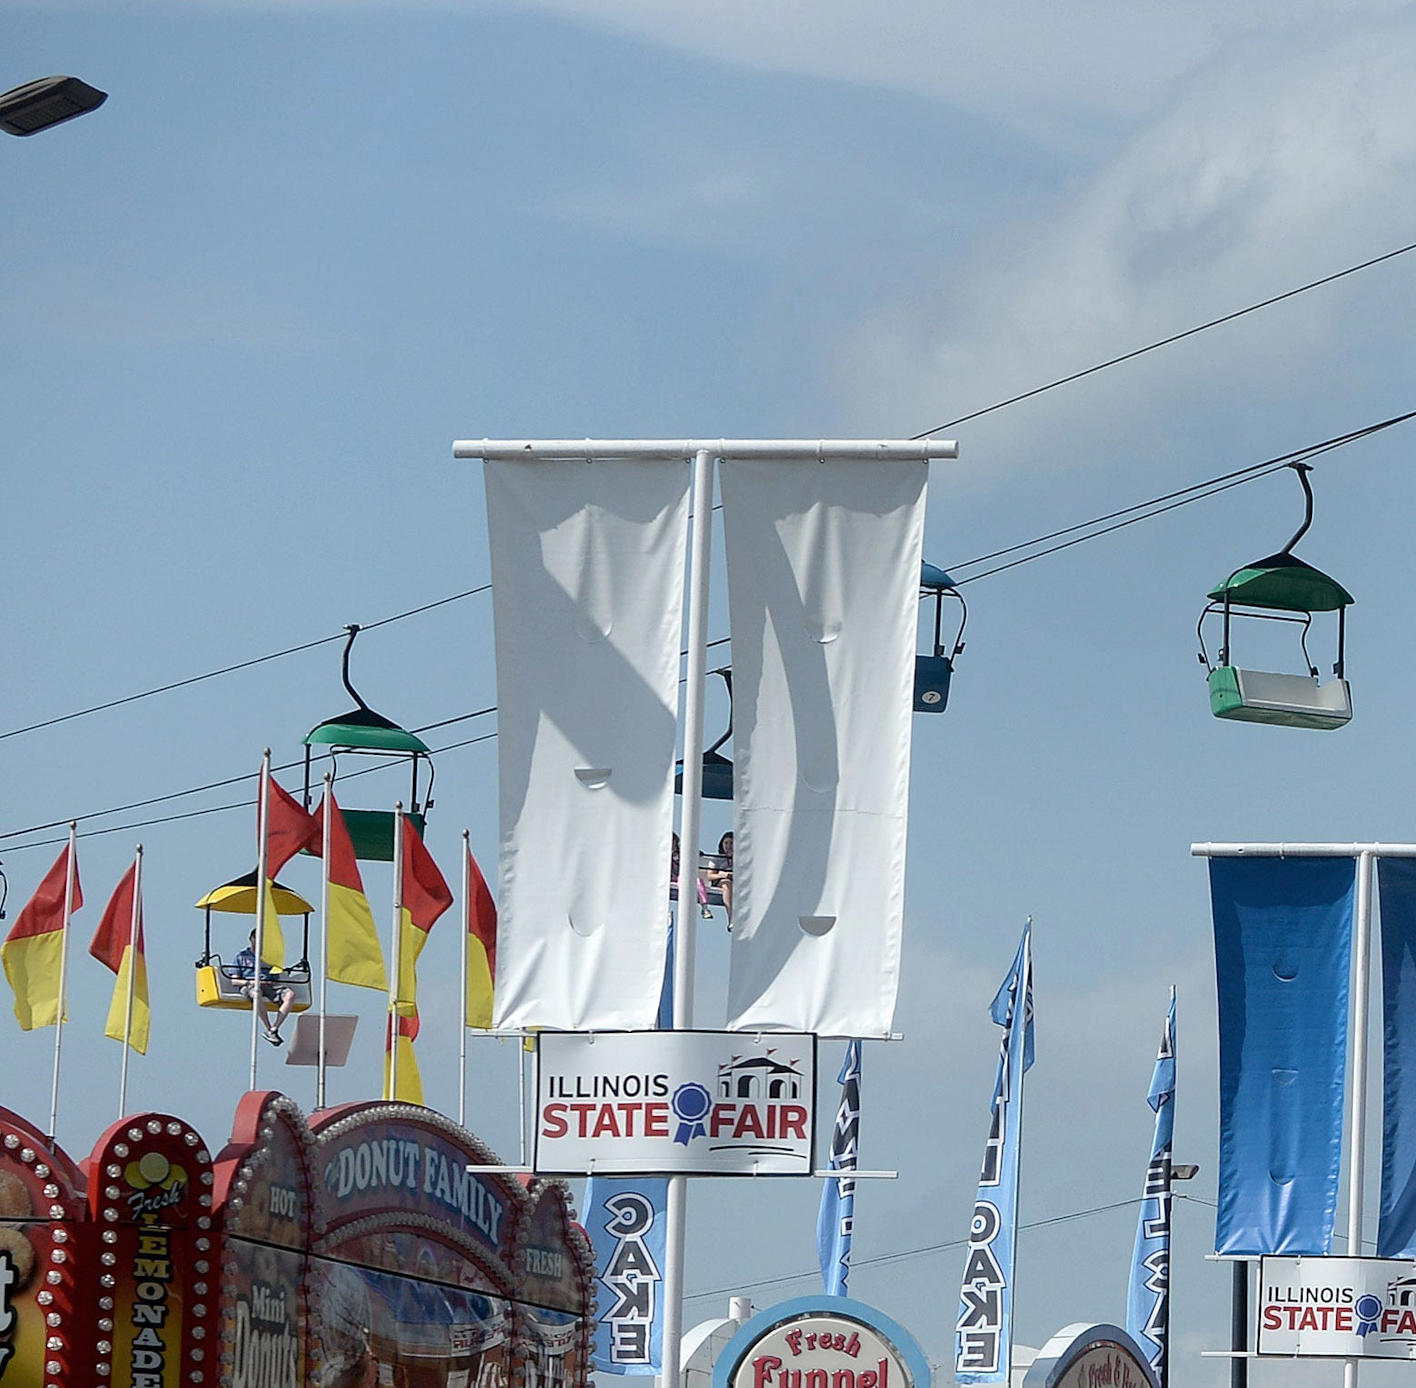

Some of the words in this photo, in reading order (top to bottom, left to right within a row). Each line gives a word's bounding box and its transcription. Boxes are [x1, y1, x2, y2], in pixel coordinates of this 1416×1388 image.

[549, 1074, 669, 1098] ILLINOIS
[542, 1102, 670, 1138] STATE
[709, 1103, 807, 1139] FAIR
[127, 1181, 183, 1220] Fresh
[269, 1186, 296, 1218] HOT
[337, 1139, 421, 1199] DONUT
[422, 1146, 504, 1245] FAMILY
[525, 1249, 563, 1278] FRESH
[251, 1285, 286, 1322] Mini
[1268, 1286, 1353, 1304] ILLINOIS
[1263, 1305, 1353, 1331] STATE
[785, 1328, 862, 1358] Fresh
